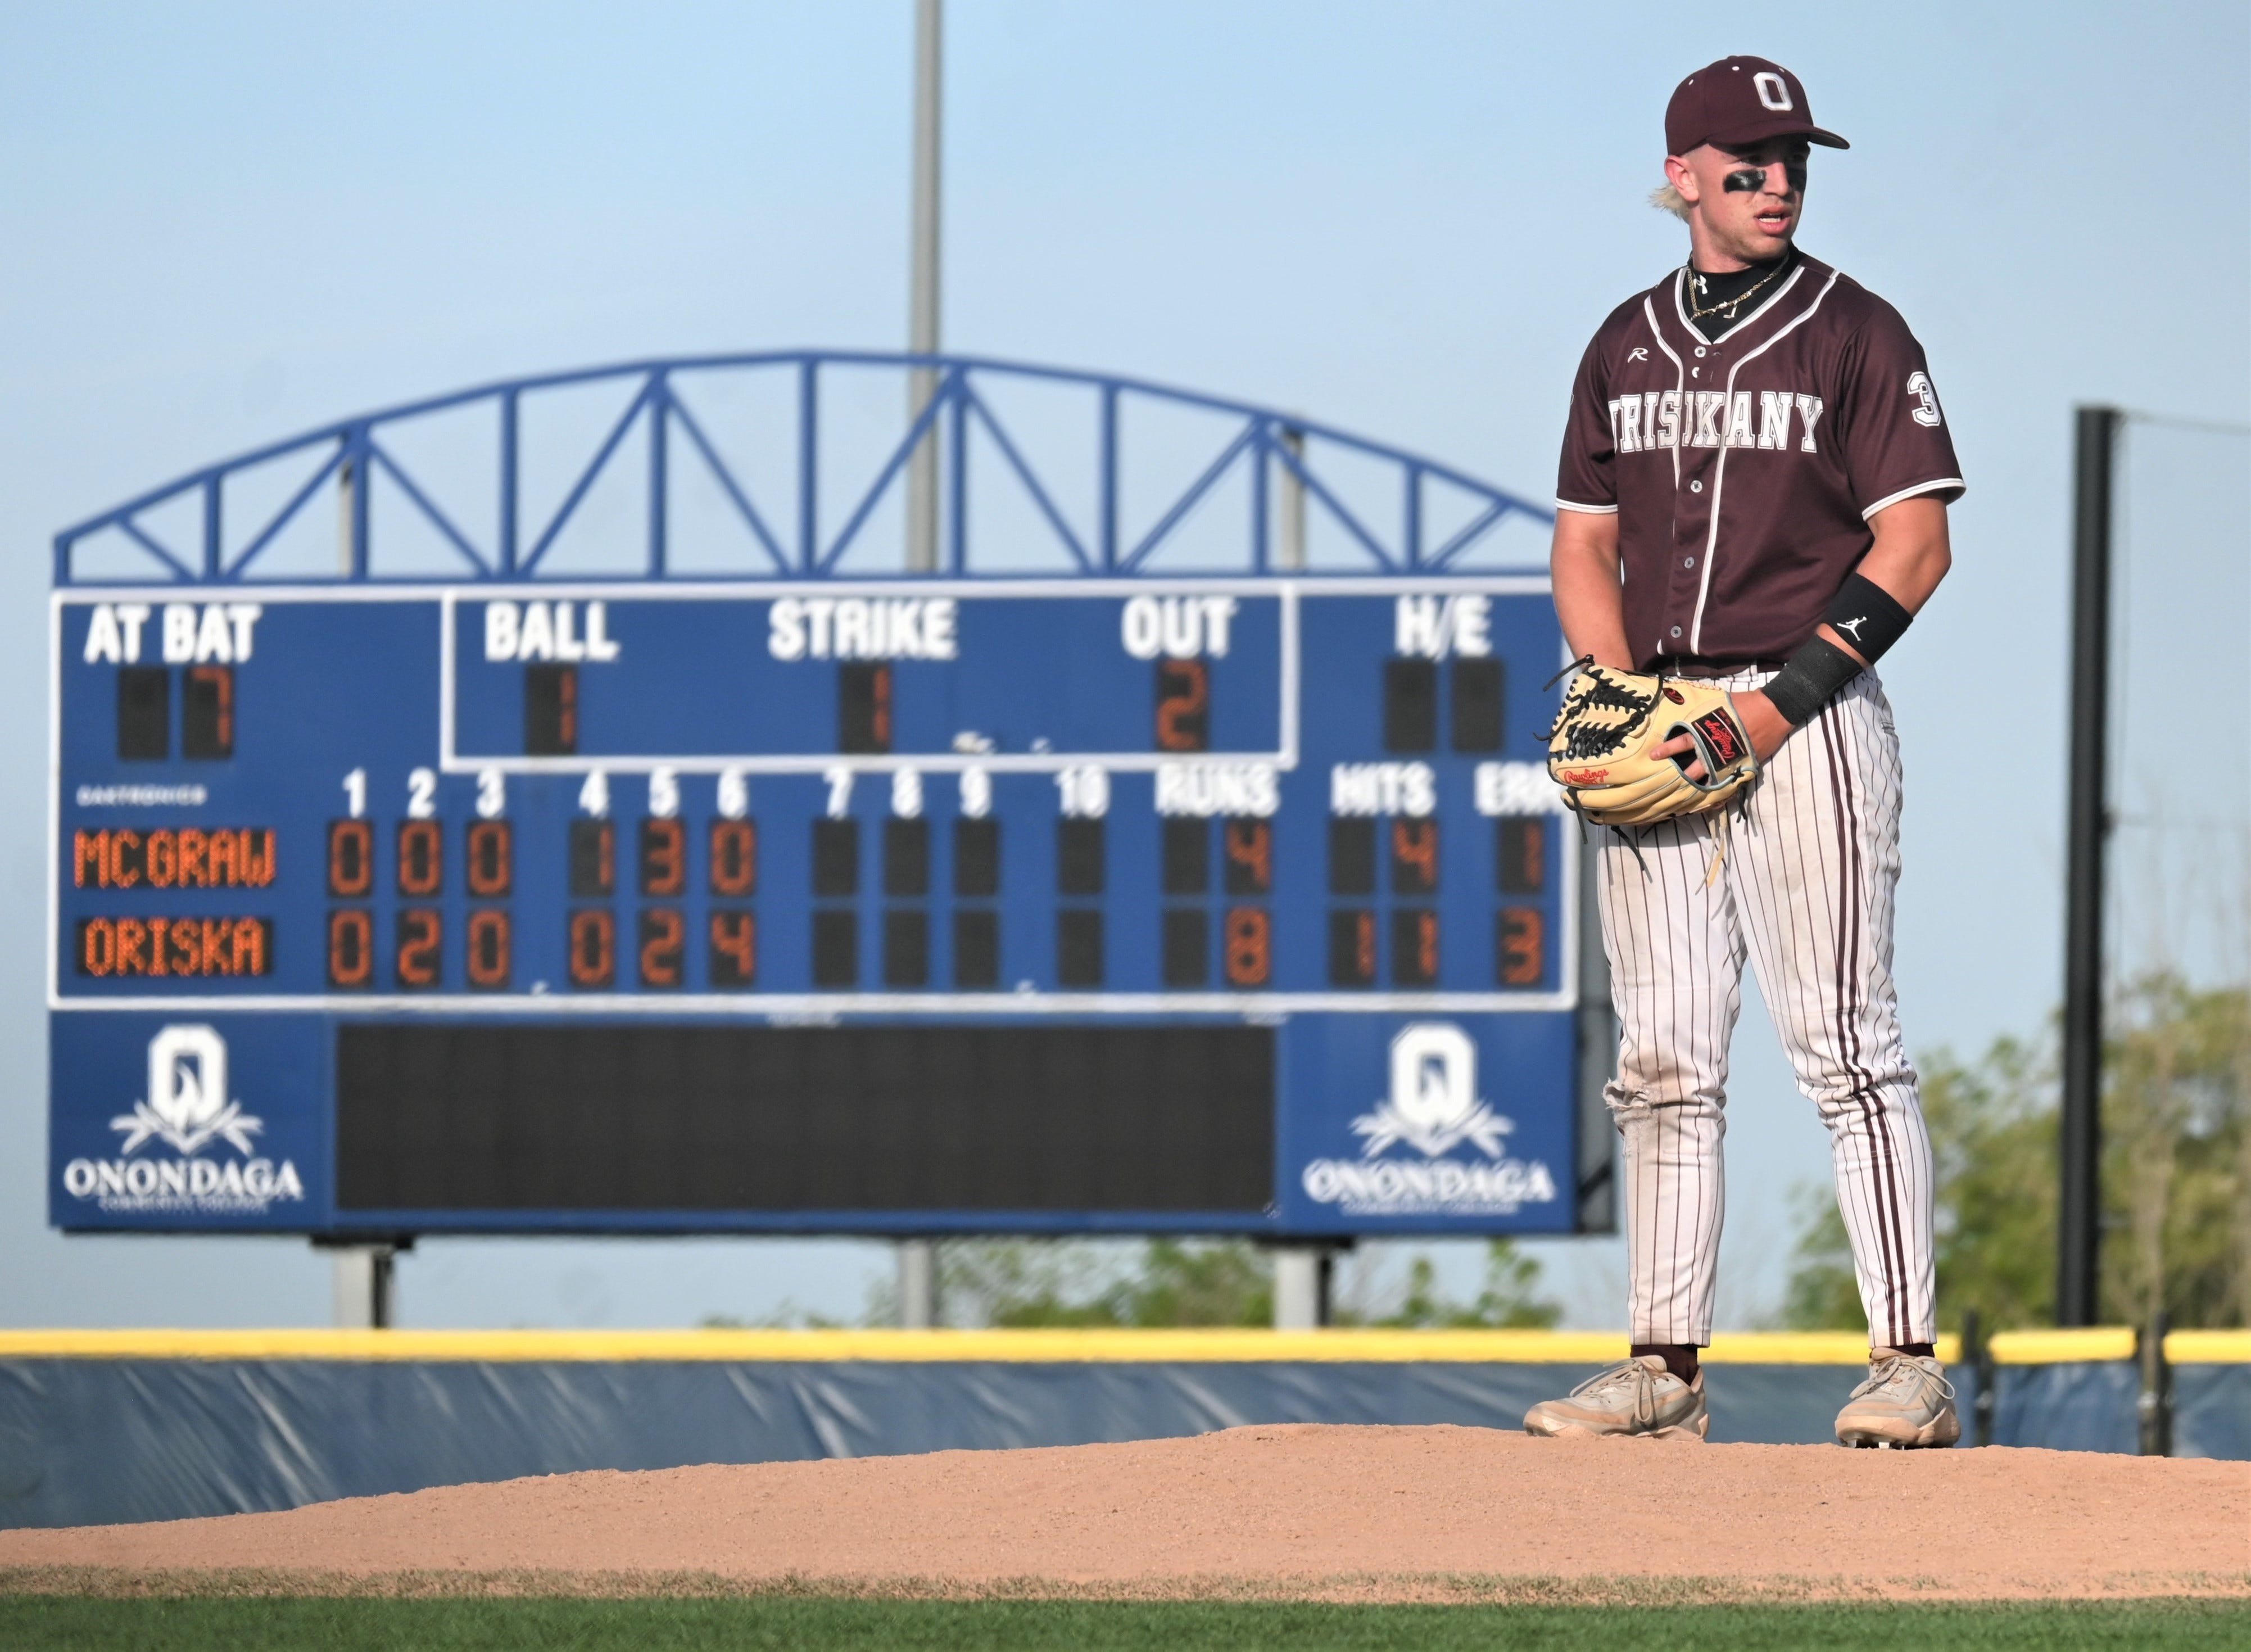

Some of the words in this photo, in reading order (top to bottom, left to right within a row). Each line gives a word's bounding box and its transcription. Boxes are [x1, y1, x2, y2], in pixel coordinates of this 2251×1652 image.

[1752, 72, 1793, 111] O
[1906, 371, 1941, 427] 3
[84, 604, 150, 663] AT
[163, 604, 262, 663] BAT
[484, 601, 620, 661] BALL
[768, 598, 957, 659] STRIKE
[1121, 596, 1239, 659] OUT
[1394, 595, 1492, 661] H/E
[192, 667, 231, 745] 7
[560, 669, 576, 745] 1
[873, 668, 890, 743] 1
[1157, 659, 1207, 749] 2
[343, 767, 365, 819] 1
[407, 767, 436, 819] 2
[476, 767, 505, 818] 3
[579, 766, 609, 818] 4
[649, 765, 680, 818] 5
[717, 765, 748, 819] 6
[823, 764, 854, 819] 7
[891, 764, 922, 819] 8
[959, 764, 991, 819] 9
[1054, 763, 1109, 818] 10
[1154, 762, 1280, 816] RUNS
[1330, 762, 1436, 816] HITS
[1564, 768, 1609, 785] Rawlings
[330, 821, 372, 895] 0
[399, 821, 441, 894] 0
[468, 821, 509, 894] 0
[599, 824, 613, 888] 1
[647, 821, 683, 894] 3
[711, 820, 753, 894] 0
[1227, 821, 1270, 888] 4
[1393, 821, 1436, 886] 4
[1524, 822, 1543, 886] 1
[85, 917, 264, 977] ORISKA
[330, 910, 372, 984] 0
[398, 910, 440, 983] 2
[468, 909, 509, 984] 0
[570, 909, 612, 984] 0
[641, 908, 682, 984] 2
[712, 912, 753, 977] 4
[1225, 907, 1270, 985] 8
[1503, 906, 1543, 984] 3
[63, 1157, 305, 1201] ONONDAGA
[1302, 1158, 1556, 1203] ONONDAGA
